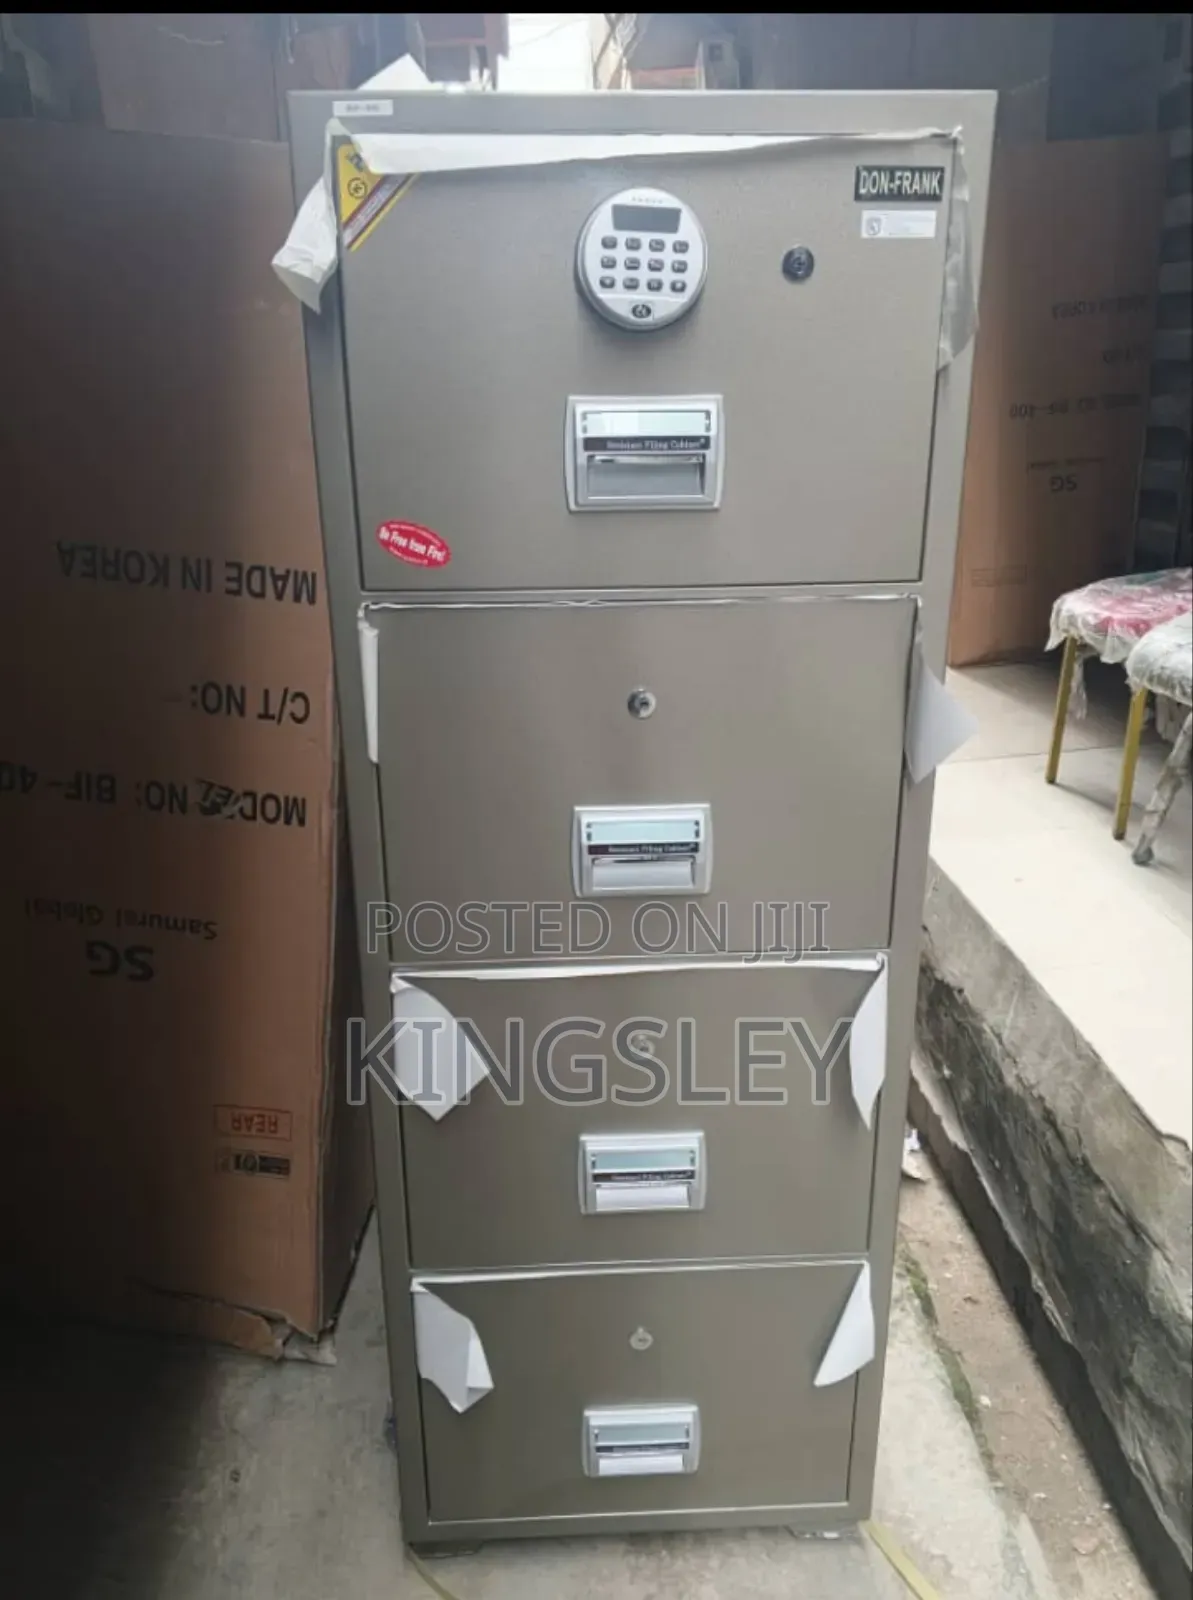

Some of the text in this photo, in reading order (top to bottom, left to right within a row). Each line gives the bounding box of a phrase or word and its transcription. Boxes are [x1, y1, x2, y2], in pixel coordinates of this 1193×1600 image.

[858, 170, 942, 196] DON-FRANK
[55, 539, 318, 606] MADE IN KOREA
[189, 681, 312, 726] C/T NO:
[134, 779, 189, 816] NO:
[85, 938, 155, 983] SG
[230, 1111, 279, 1134] REAR
